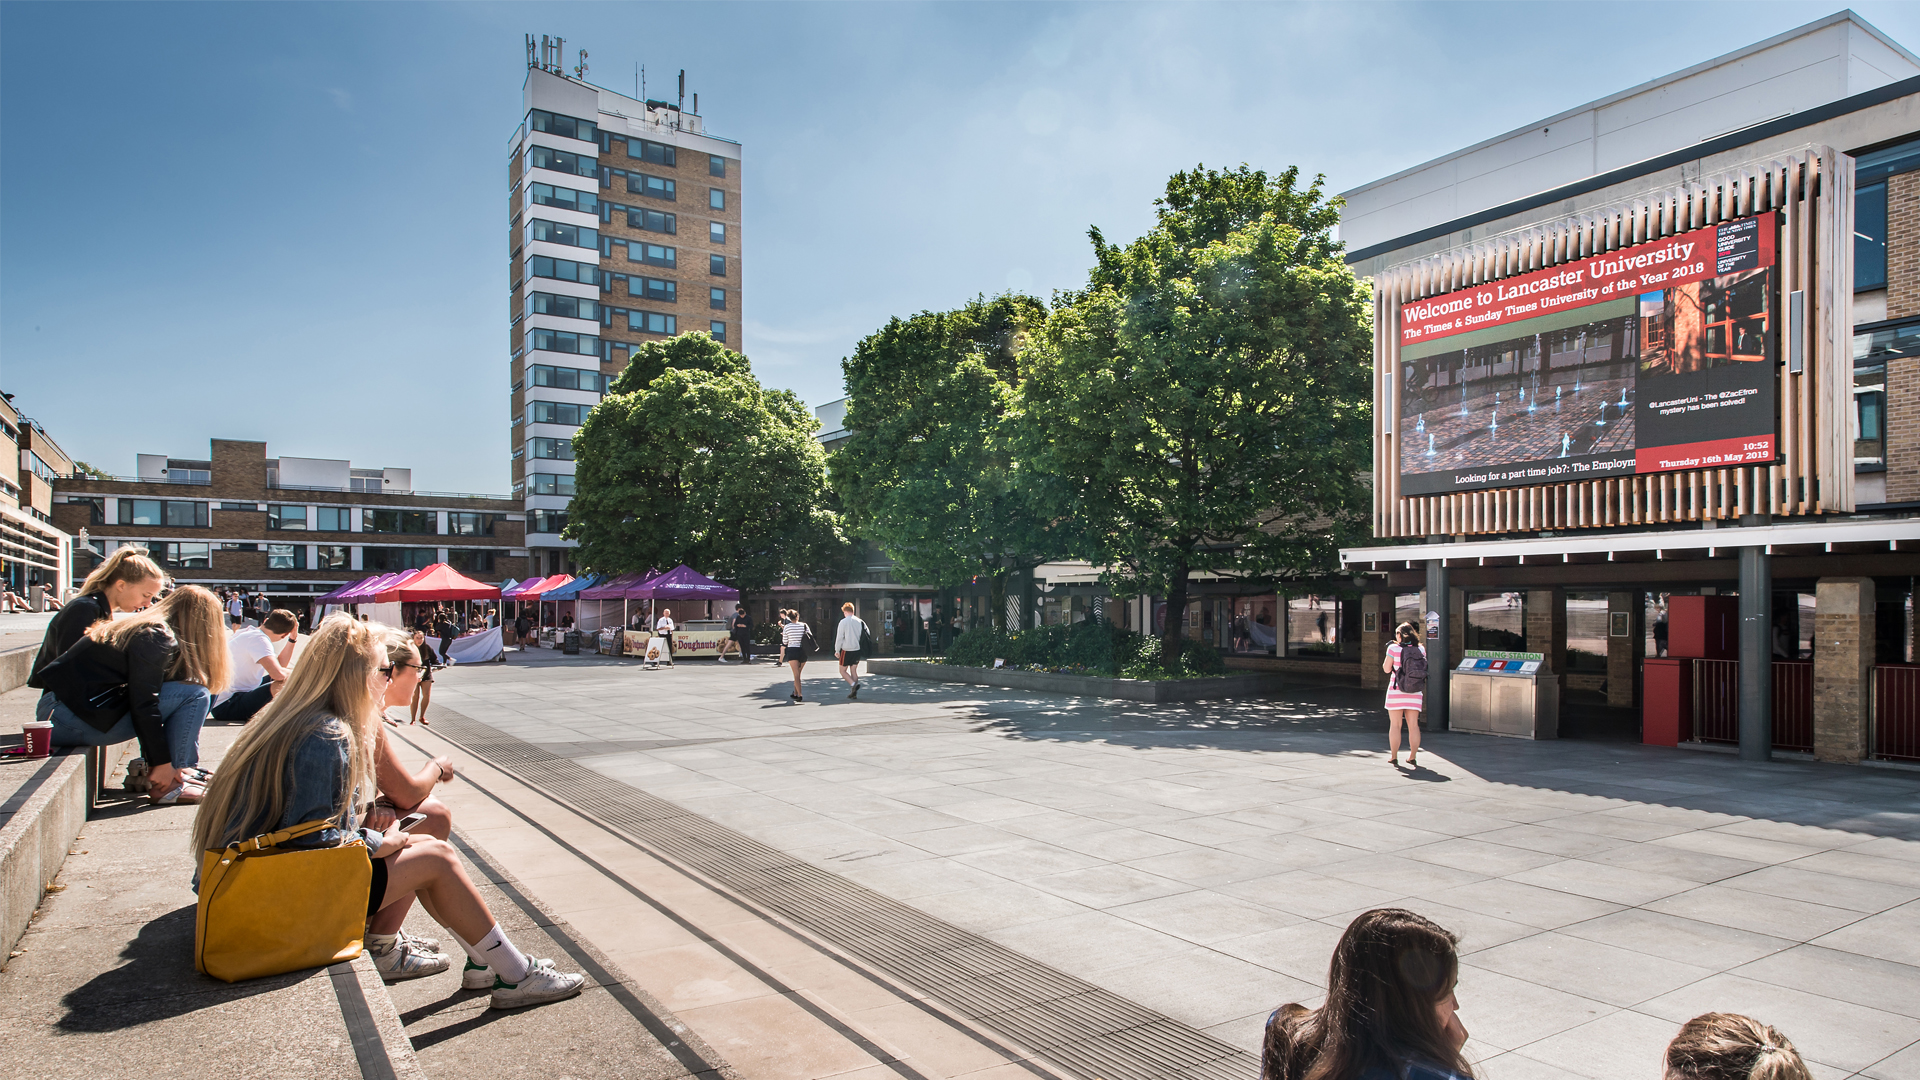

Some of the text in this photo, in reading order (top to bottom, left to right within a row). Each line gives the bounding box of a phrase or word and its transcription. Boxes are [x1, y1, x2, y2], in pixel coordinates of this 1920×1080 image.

[1718, 234, 1735, 242] GOOD
[1718, 235, 1751, 247] UNIVERSITY
[1718, 244, 1735, 252] GUIDE
[1718, 255, 1746, 265] UNIVERSITY
[1404, 242, 1695, 323] Welcome to Lancaster University
[1404, 262, 1704, 339] The Times & Sunday Times University of the Year 2018
[1649, 396, 1698, 409] @LancasterUni
[1704, 393, 1718, 401] The
[1719, 388, 1758, 399] @ZacEfron
[1660, 397, 1746, 415] mystery has been solved!
[1743, 441, 1769, 451] 10:52
[1659, 450, 1769, 468] Thursday 16th May 2019
[1455, 458, 1636, 484] Looking for a part time job?: The Employm
[678, 640, 716, 652] Doughnuts
[1467, 650, 1541, 660] RECYCLING STATION
